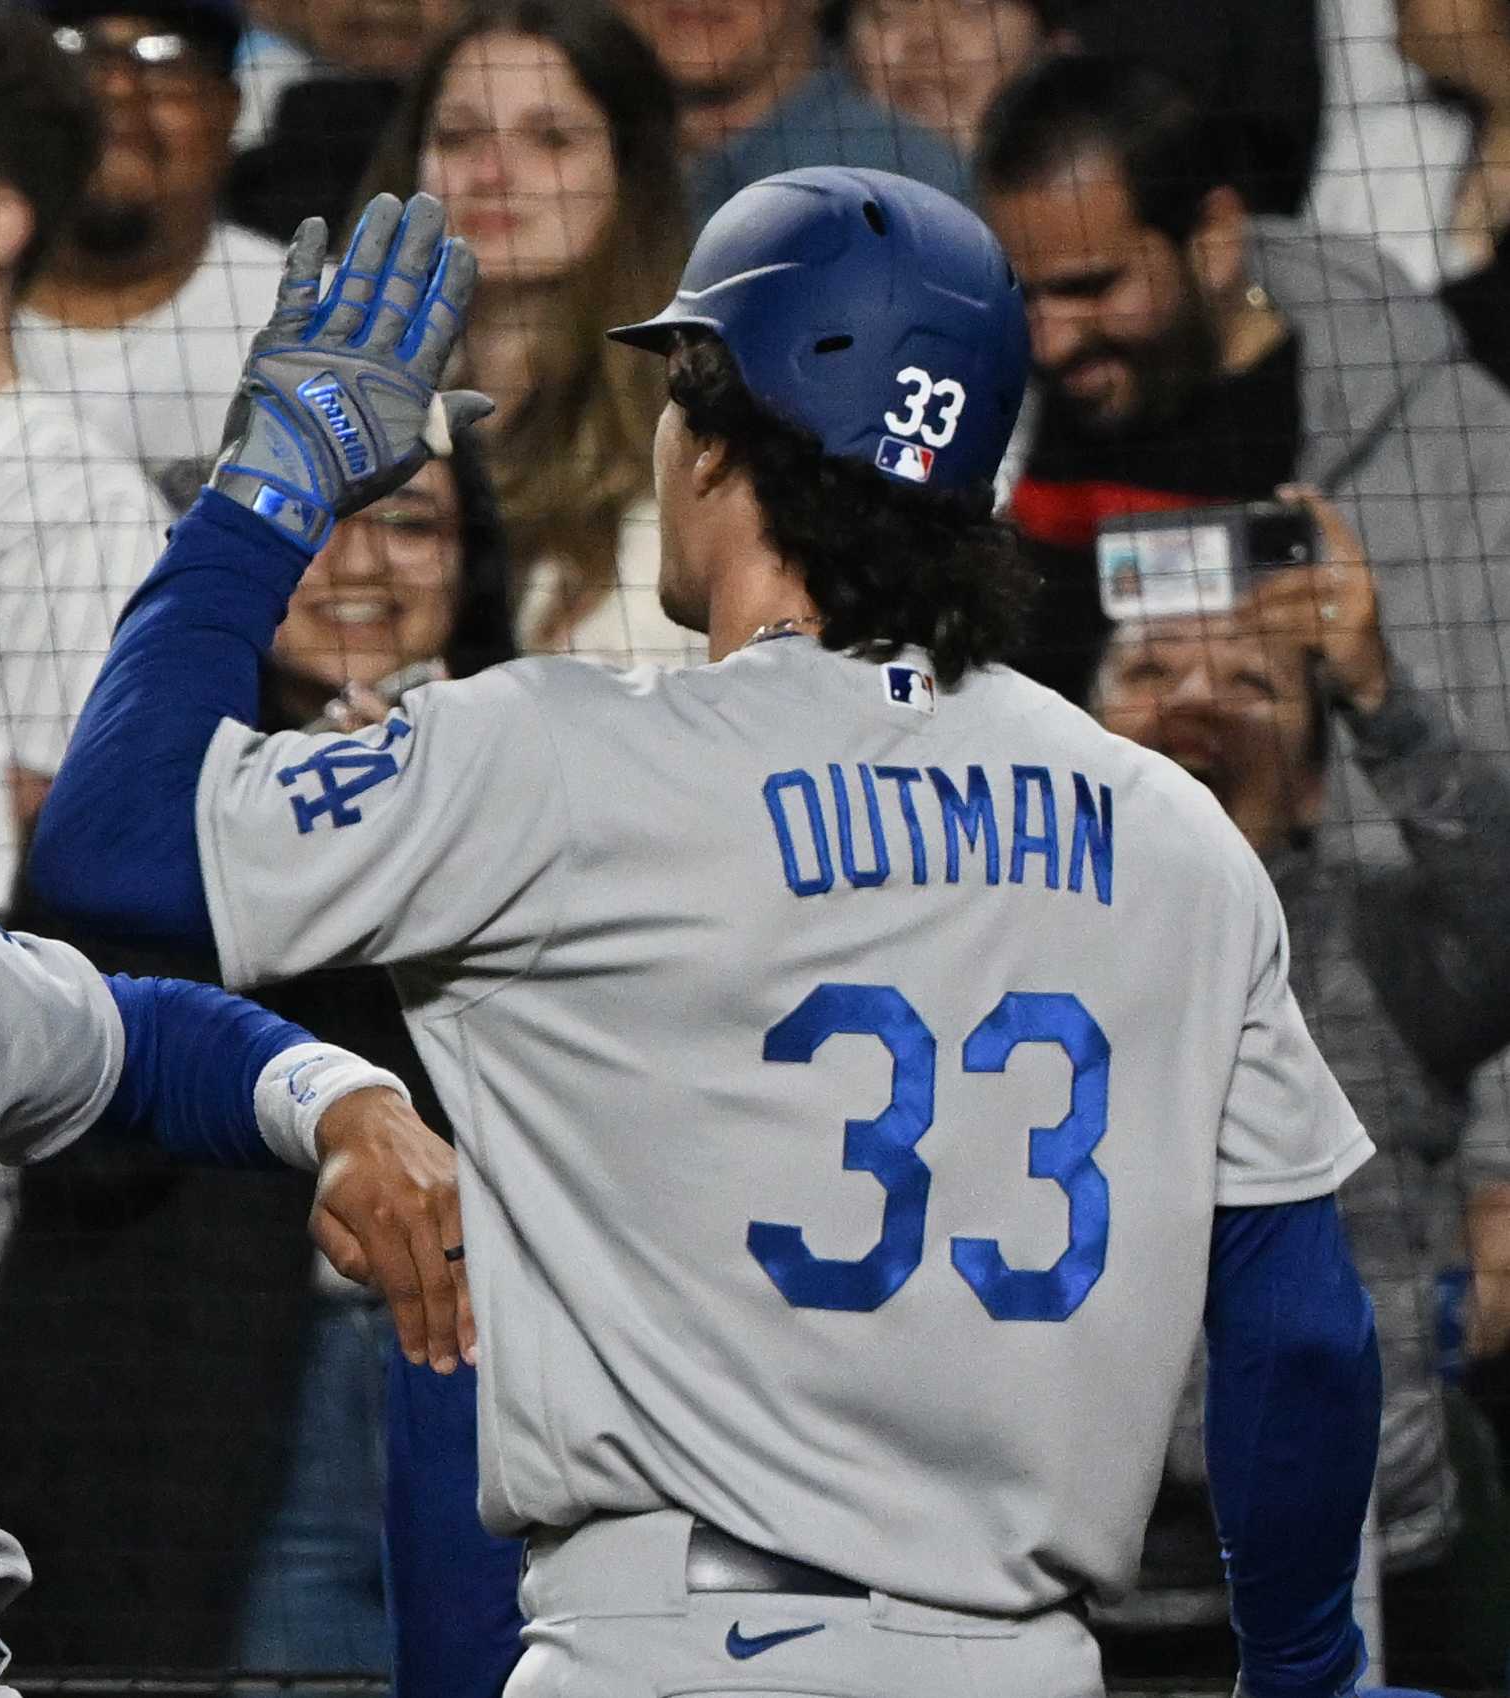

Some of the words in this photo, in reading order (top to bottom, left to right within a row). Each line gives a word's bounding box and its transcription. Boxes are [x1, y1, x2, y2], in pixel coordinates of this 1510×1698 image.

[303, 382, 368, 475] Franklin
[884, 366, 966, 448] 33
[276, 717, 412, 834] LA
[762, 763, 1113, 906] OUTMAN
[746, 983, 1111, 1321] 33
